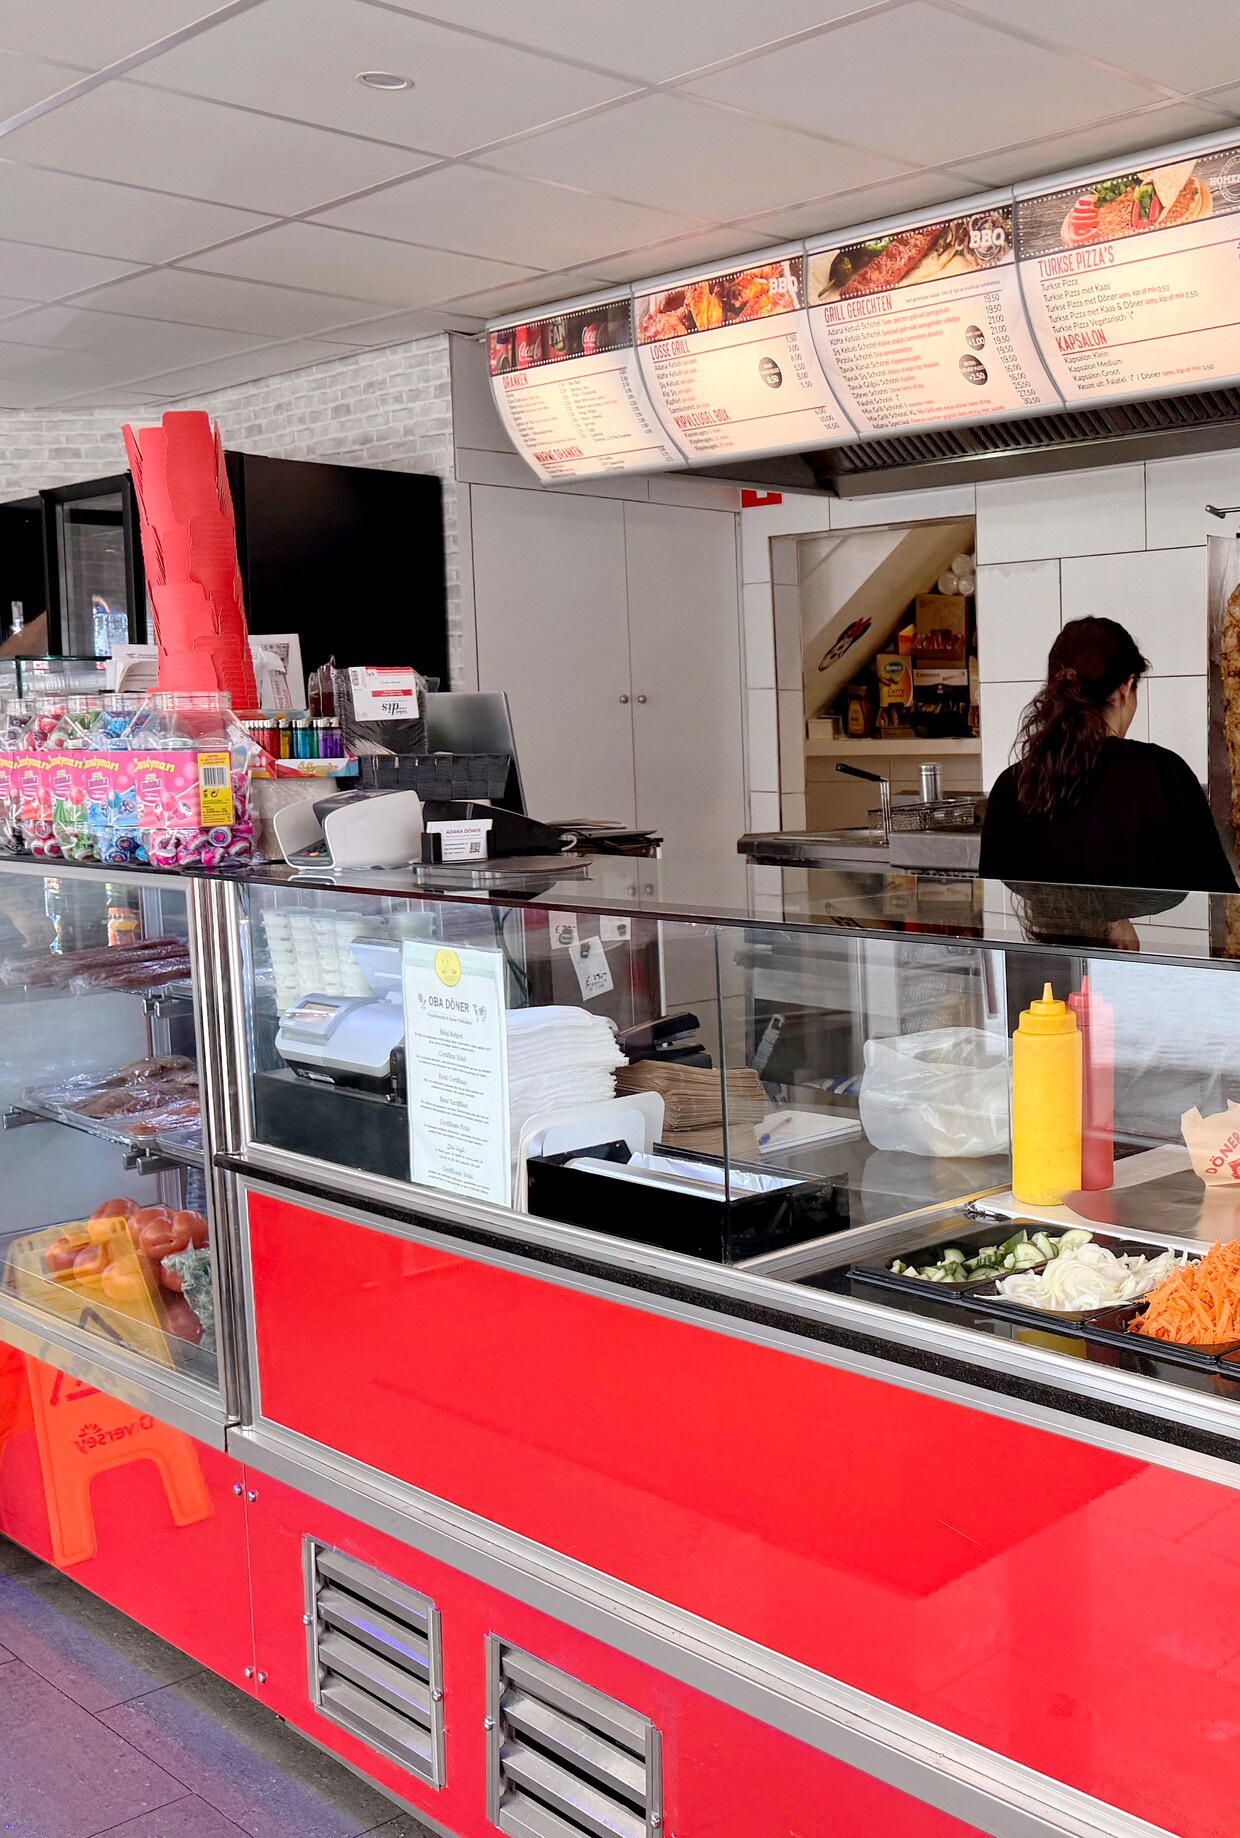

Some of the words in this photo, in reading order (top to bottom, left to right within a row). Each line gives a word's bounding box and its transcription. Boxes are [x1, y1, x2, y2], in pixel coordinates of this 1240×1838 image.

[970, 228, 1005, 249] BBQ
[1037, 254, 1074, 277] TURKSE
[1076, 246, 1114, 270] PIZZA'S
[1062, 279, 1078, 287] Pizza
[824, 304, 845, 323] GRILL
[847, 294, 892, 318] GERECHTEN
[650, 342, 669, 360] LOSSE
[672, 339, 690, 356] GRILL
[1055, 329, 1107, 352] KAPSALON
[718, 408, 732, 421] BOX
[429, 996, 444, 1008] OBA
[446, 998, 469, 1013] DÖNER
